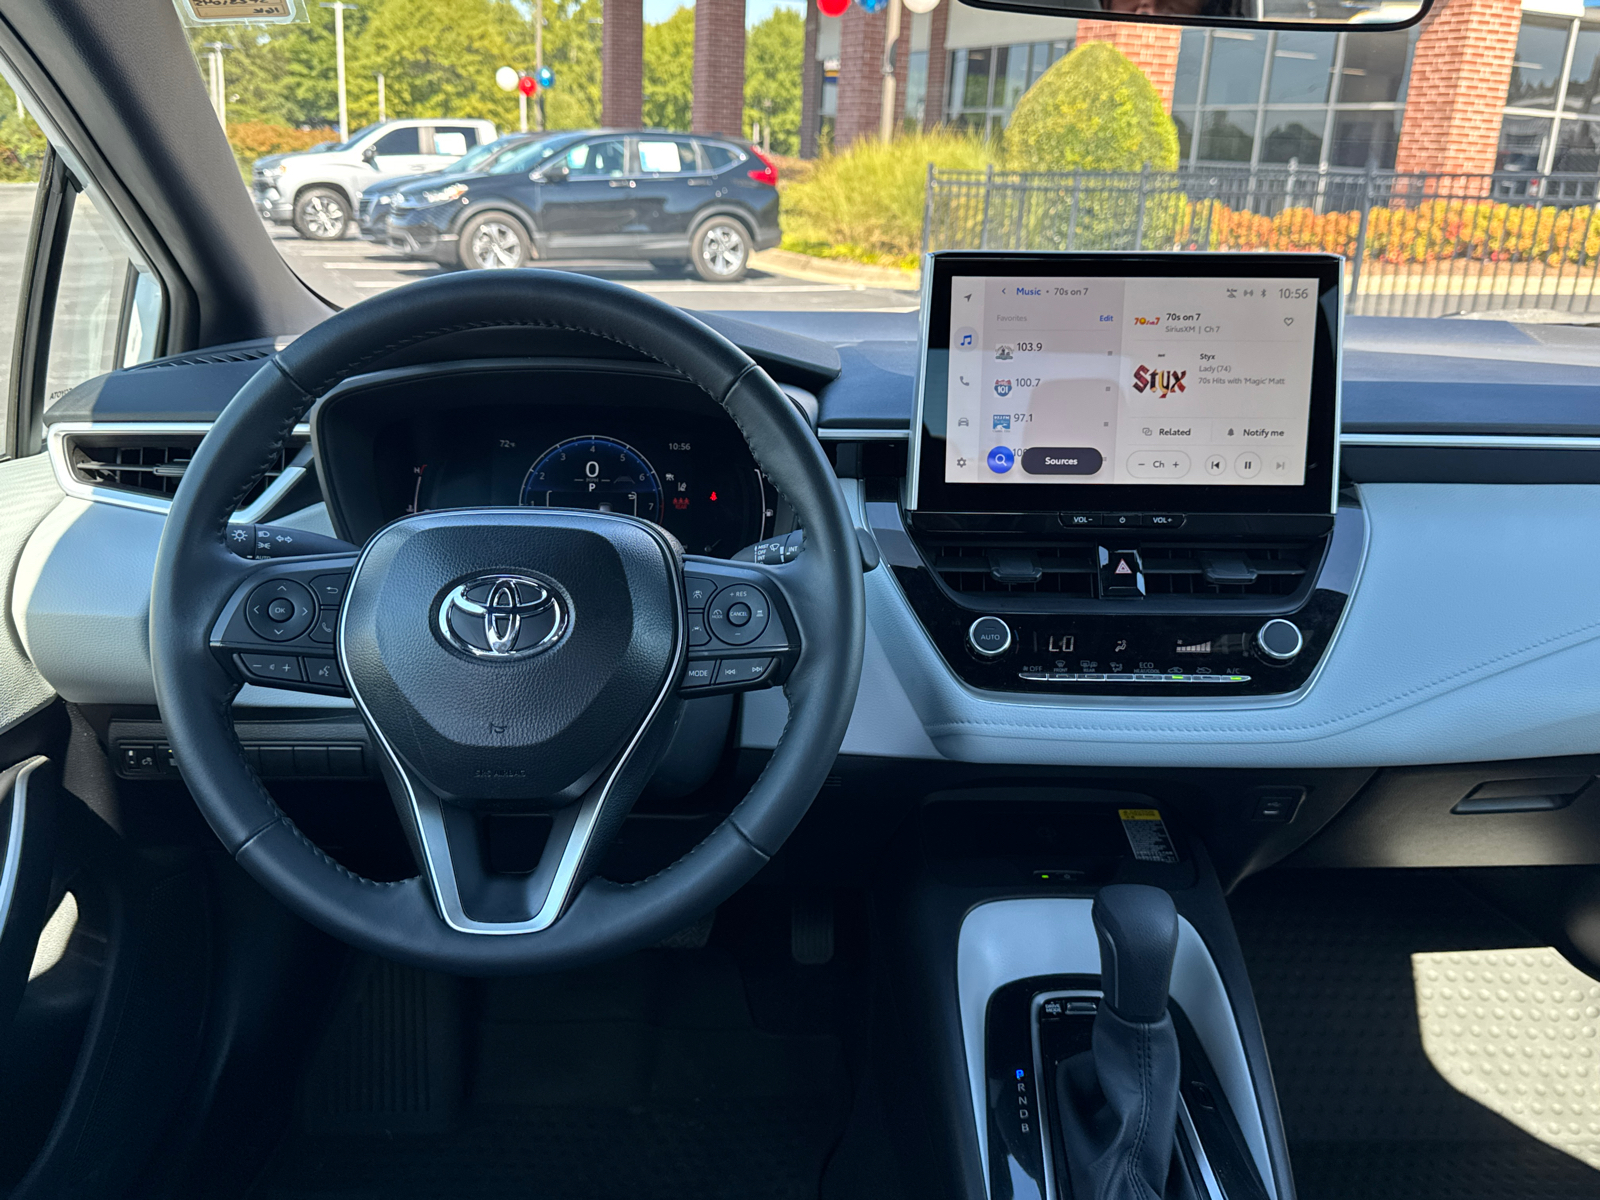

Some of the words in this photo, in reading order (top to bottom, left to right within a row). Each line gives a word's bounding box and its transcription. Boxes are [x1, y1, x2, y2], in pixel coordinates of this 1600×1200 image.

[1016, 287, 1041, 296] Music
[1054, 288, 1068, 296] 70s
[1083, 288, 1089, 296] 7
[1278, 289, 1309, 299] 10:56
[996, 314, 1028, 323] Favorites
[1166, 313, 1181, 321] 70s
[1195, 313, 1201, 321] 7
[1016, 343, 1043, 352] 103.9
[1199, 353, 1216, 362] Styx
[1199, 365, 1216, 374] Lady
[1216, 365, 1232, 374] (74)
[1015, 378, 1041, 387] 100.7
[1198, 377, 1211, 385] 70s
[1212, 377, 1226, 385] Hits
[1227, 377, 1243, 385] with
[1268, 377, 1285, 385] Matt
[1013, 414, 1034, 423] 97.1
[1158, 428, 1191, 436] Related
[1243, 429, 1269, 438] Notify
[589, 445, 596, 453] 4
[669, 443, 691, 451] 10:56
[560, 453, 566, 461] 3
[1045, 457, 1078, 465] Sources
[1153, 460, 1165, 468] Ch
[585, 461, 600, 478] 0
[539, 472, 546, 480] 2
[639, 473, 646, 481] 6
[588, 483, 597, 492] P
[981, 633, 1000, 641] AUTO
[1139, 661, 1154, 669] ECO
[1015, 1069, 1024, 1079] P
[1017, 1083, 1026, 1092] R
[1018, 1096, 1027, 1105] N
[1019, 1109, 1029, 1119] D
[1021, 1123, 1030, 1133] B
